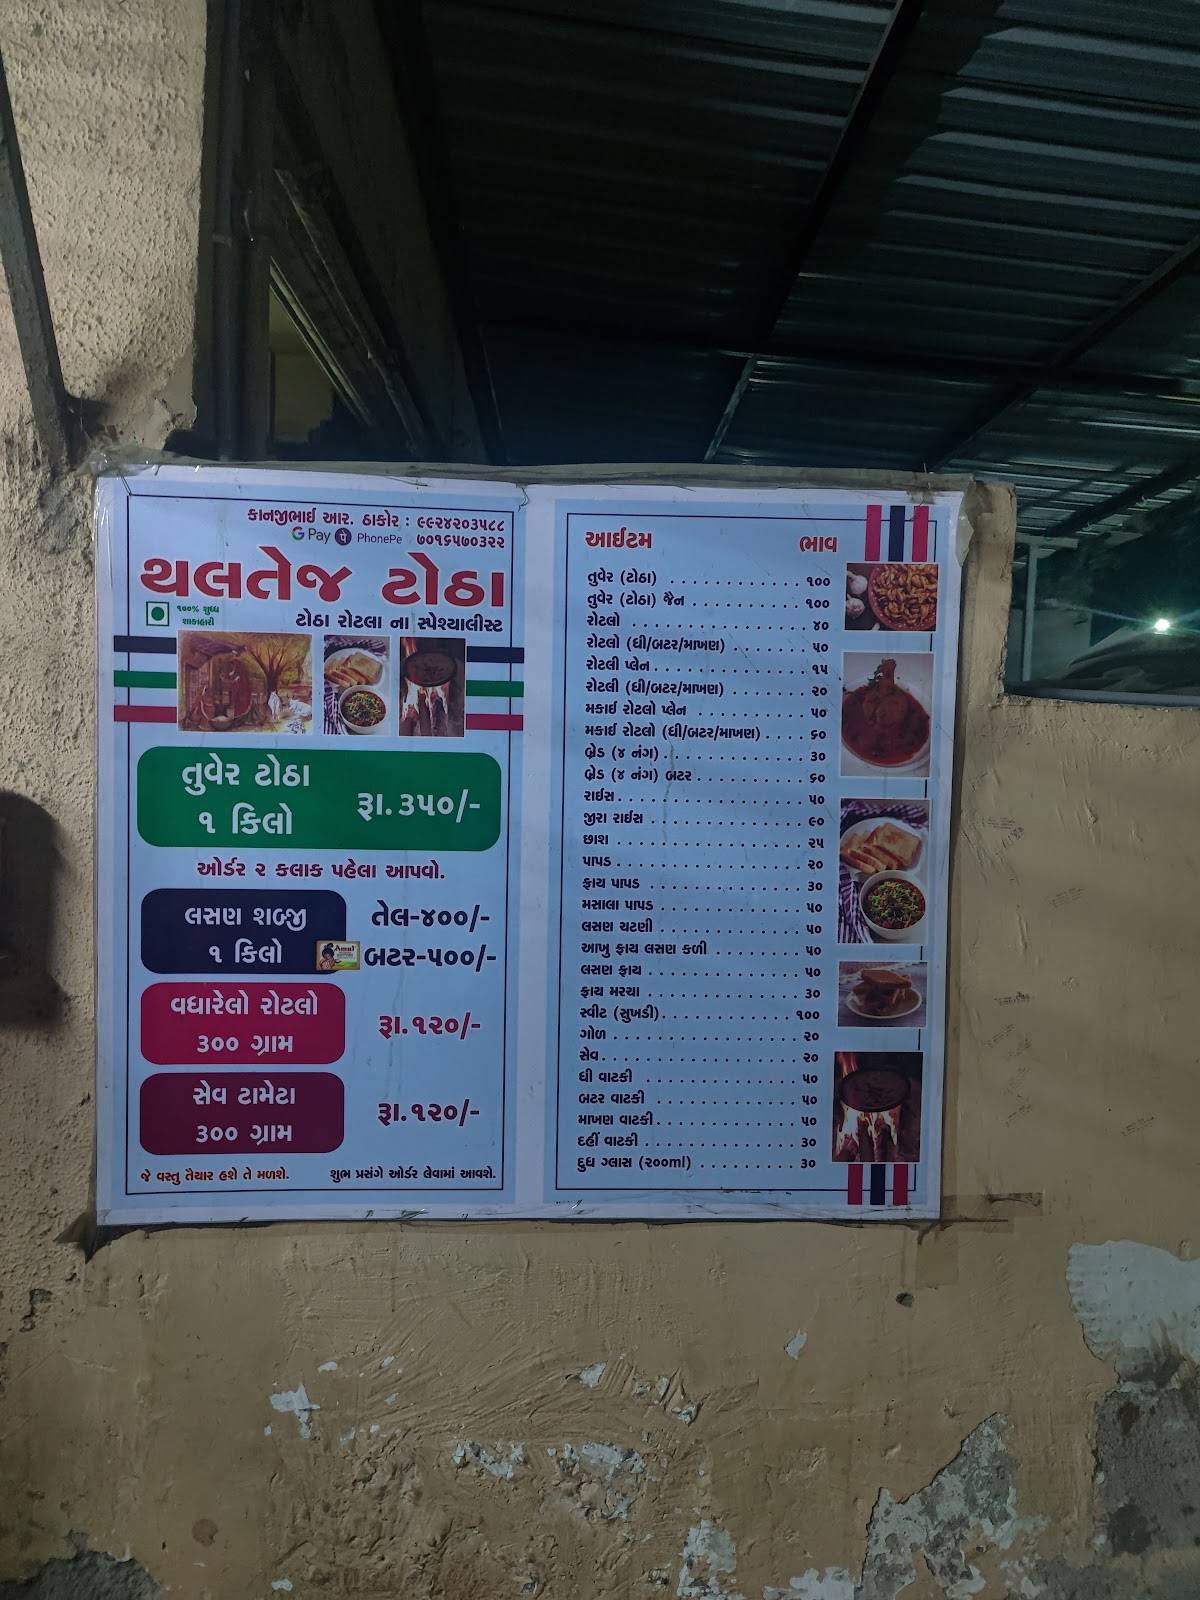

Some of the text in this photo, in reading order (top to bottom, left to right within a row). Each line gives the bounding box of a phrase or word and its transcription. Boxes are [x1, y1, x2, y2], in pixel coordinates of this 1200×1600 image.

[248, 508, 316, 526] કાનજીભાઈ
[323, 512, 354, 525] આર.
[362, 510, 399, 527] ઠાકોર
[416, 516, 505, 532] ૯૯૨૪૨૦૩૫૮૮
[308, 527, 331, 545] Pay
[357, 532, 403, 545] PhonePe
[416, 534, 505, 549] ૭૦૧૬૫૭૦૩૨૨
[585, 527, 838, 552] આઈટમ ભાવ
[140, 546, 505, 607] થલતેજ ટોઠા
[587, 568, 831, 587] તુવેર (ટોઠા) ૧૦૦
[587, 590, 830, 609] તુવેર (ટોઠા) જૈન ૧૦૦
[295, 608, 503, 633] ટોઠા રોટલા ના સ્પેશ્યાલીસ્ટ
[586, 611, 829, 631] રોટલો ૪૦
[586, 634, 620, 649] રોટલો
[812, 642, 829, 653] ૫૦
[586, 656, 828, 675] રોટલી પ્લેન ૧૫
[585, 677, 619, 693] રોટલી
[811, 686, 828, 697] ૨૦
[585, 700, 827, 718] મકાઈ રોટલો પ્લેન ૫૦
[585, 722, 618, 736] મકાઈ
[622, 721, 656, 737] રોટલો
[810, 730, 827, 740] ૬૦
[584, 743, 826, 762] બ્રેડ (૪ નંગ) ૩૦
[181, 753, 310, 796] તુવેર ટોઠા
[584, 765, 826, 783] બ્રેડ (૪ નંગ) બટર ૬૦
[584, 788, 825, 805] રાઈસ ૫૦
[199, 802, 293, 835] ૧ કિલો
[583, 810, 825, 827] જીરા રાઈસ ૯૦
[583, 833, 824, 849] છાશ ૨૫
[197, 856, 445, 879] ઓર્ડર ૨ કલાક પહેલા આપવો.
[583, 855, 824, 870] પાપડ ૨૦
[582, 877, 823, 892] ફ્રાય પાપડ ૩૦
[371, 899, 490, 932] તેલ-૪૦૦/-
[581, 899, 823, 913] મસાલા પાપડ ૫૦
[184, 907, 307, 931] લસણ શબ્જી
[581, 918, 822, 934] લસણ ચટણી ૫૦
[208, 938, 282, 963] ૧ કિલો
[364, 944, 496, 972] બટર-૫૦૦/-
[581, 940, 822, 959] આખુ ફ્રાય લસણ કળી ૫૦
[580, 964, 821, 977] લસણ ફ્રાય ૫૦
[580, 985, 821, 999] ફ્રાય મરચા ૩૦
[260, 989, 318, 1015] રોટલો
[580, 1004, 820, 1023] સ્વીટ (સુખડી) ૧૦૦
[579, 1025, 820, 1041] ગોળ ૨૦
[196, 1034, 294, 1056] ૩૦૦ ગ્રામ
[579, 1046, 819, 1063] સેવ ૨૦
[598, 1068, 633, 1083] વાટકી
[802, 1074, 818, 1084] ૫૦
[192, 1080, 295, 1105] સેવ ટામેટા
[578, 1089, 818, 1106] બટર વાટકી ૫૦
[578, 1111, 817, 1127] માખણ વાટકી ૫૦
[196, 1126, 293, 1145] ૩૦૦ ગ્રામ
[577, 1131, 817, 1148] દહીં વાટકી ૩૦
[601, 1157, 633, 1169] ગ્લાસ
[800, 1159, 816, 1169] ૩૦
[140, 1166, 289, 1185] જે વસ્તુ તૈયાર હશે તે મળશે.
[329, 1165, 496, 1183] શુભ પ્રસંગે ઓર્ડર લેવામાં આવશે.
